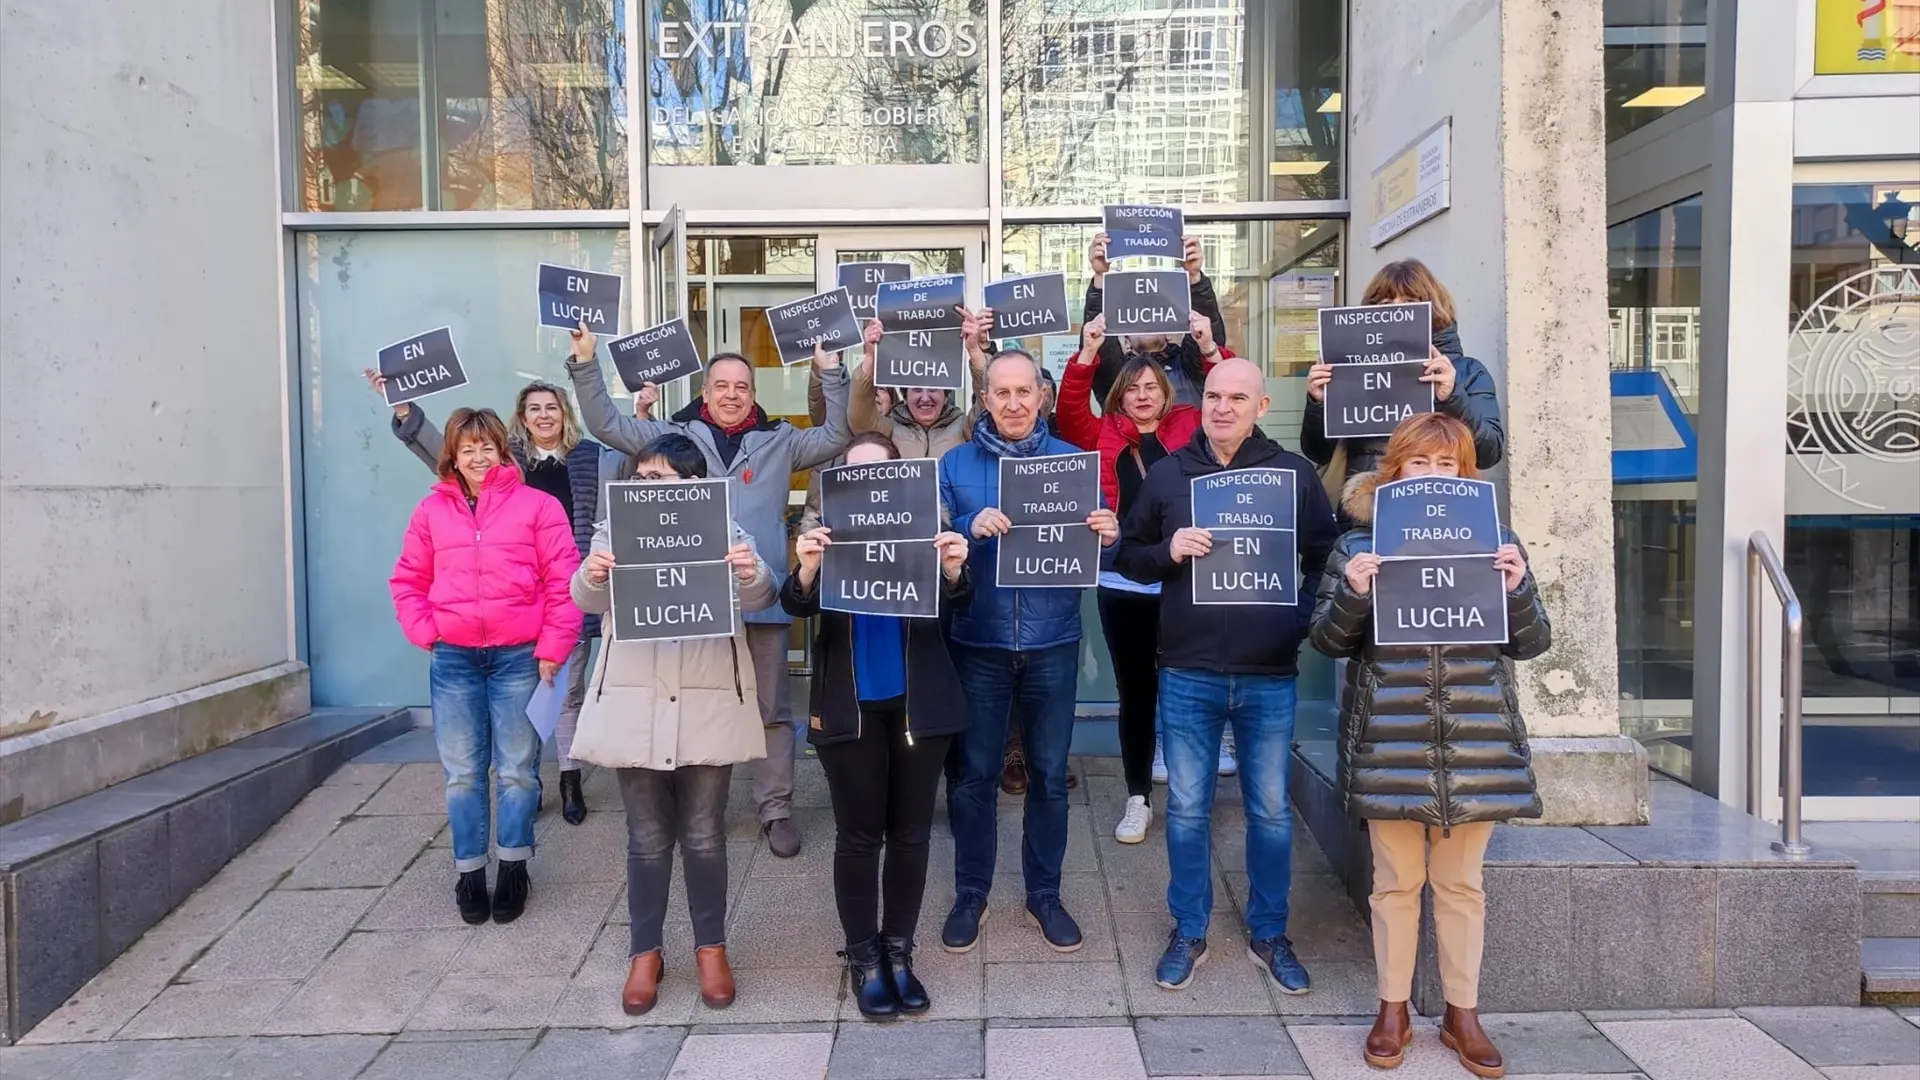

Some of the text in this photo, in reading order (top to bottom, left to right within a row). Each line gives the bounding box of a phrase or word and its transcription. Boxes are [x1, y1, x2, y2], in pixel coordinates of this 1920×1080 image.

[658, 20, 978, 59] EXTRANJEROS
[858, 106, 957, 126] GOBIERN
[732, 135, 761, 154] EN
[1115, 207, 1173, 219] INSPECCIÓN
[1138, 223, 1152, 234] DE
[1123, 237, 1169, 247] TRABAJO
[567, 275, 589, 294] EN
[864, 268, 885, 283] EN
[1013, 283, 1035, 300] EN
[1135, 278, 1158, 294] EN
[849, 294, 877, 310] LUC
[913, 292, 928, 303] DE
[552, 301, 605, 325] LUCHA
[780, 294, 838, 320] INSPECCIÓN
[896, 307, 946, 321] TRABAJO
[1117, 306, 1177, 324] LUCHA
[807, 317, 821, 330] DE
[999, 308, 1056, 329] LUCHA
[1335, 308, 1415, 325] INSPECCIÓN
[618, 325, 677, 352] INSPECCIÓN
[796, 329, 841, 349] TRAAJO
[908, 331, 932, 347] EN
[1366, 332, 1384, 345] DE
[403, 341, 425, 361] EN
[645, 348, 661, 361] DE
[637, 358, 681, 381] TRABAJO
[890, 359, 949, 378] LUCHA
[395, 364, 452, 392] LUCHA
[1363, 371, 1392, 390] EN
[1343, 404, 1414, 424] LUCHA
[836, 463, 921, 482] INSPECCIÓN
[1014, 457, 1086, 475] INSPECCIÓN
[1043, 481, 1060, 494] DE
[1206, 472, 1281, 490] INSPECCIÓN
[624, 485, 711, 503] INSPECCIÓN
[870, 489, 889, 503] DE
[1236, 493, 1254, 505] DE
[1391, 482, 1479, 499] INSPECCIÓN
[1022, 500, 1078, 514] TRABAJO
[1426, 504, 1447, 517] DE
[659, 512, 679, 526] DE
[848, 511, 912, 527] TRABAJO
[1216, 512, 1274, 526] TRABAJO
[636, 534, 703, 549] TRABAJO
[1038, 526, 1064, 542] EN
[1401, 527, 1472, 541] TRABAJO
[865, 543, 895, 563] EN
[1233, 536, 1260, 556] EN
[1015, 557, 1082, 575] LUCHA
[656, 567, 687, 588] EN
[1212, 571, 1283, 591] LUCHA
[1421, 566, 1455, 588] EN
[840, 579, 919, 602] LUCHA
[634, 602, 714, 626] LUCHA
[1397, 606, 1485, 629] LUCHA
